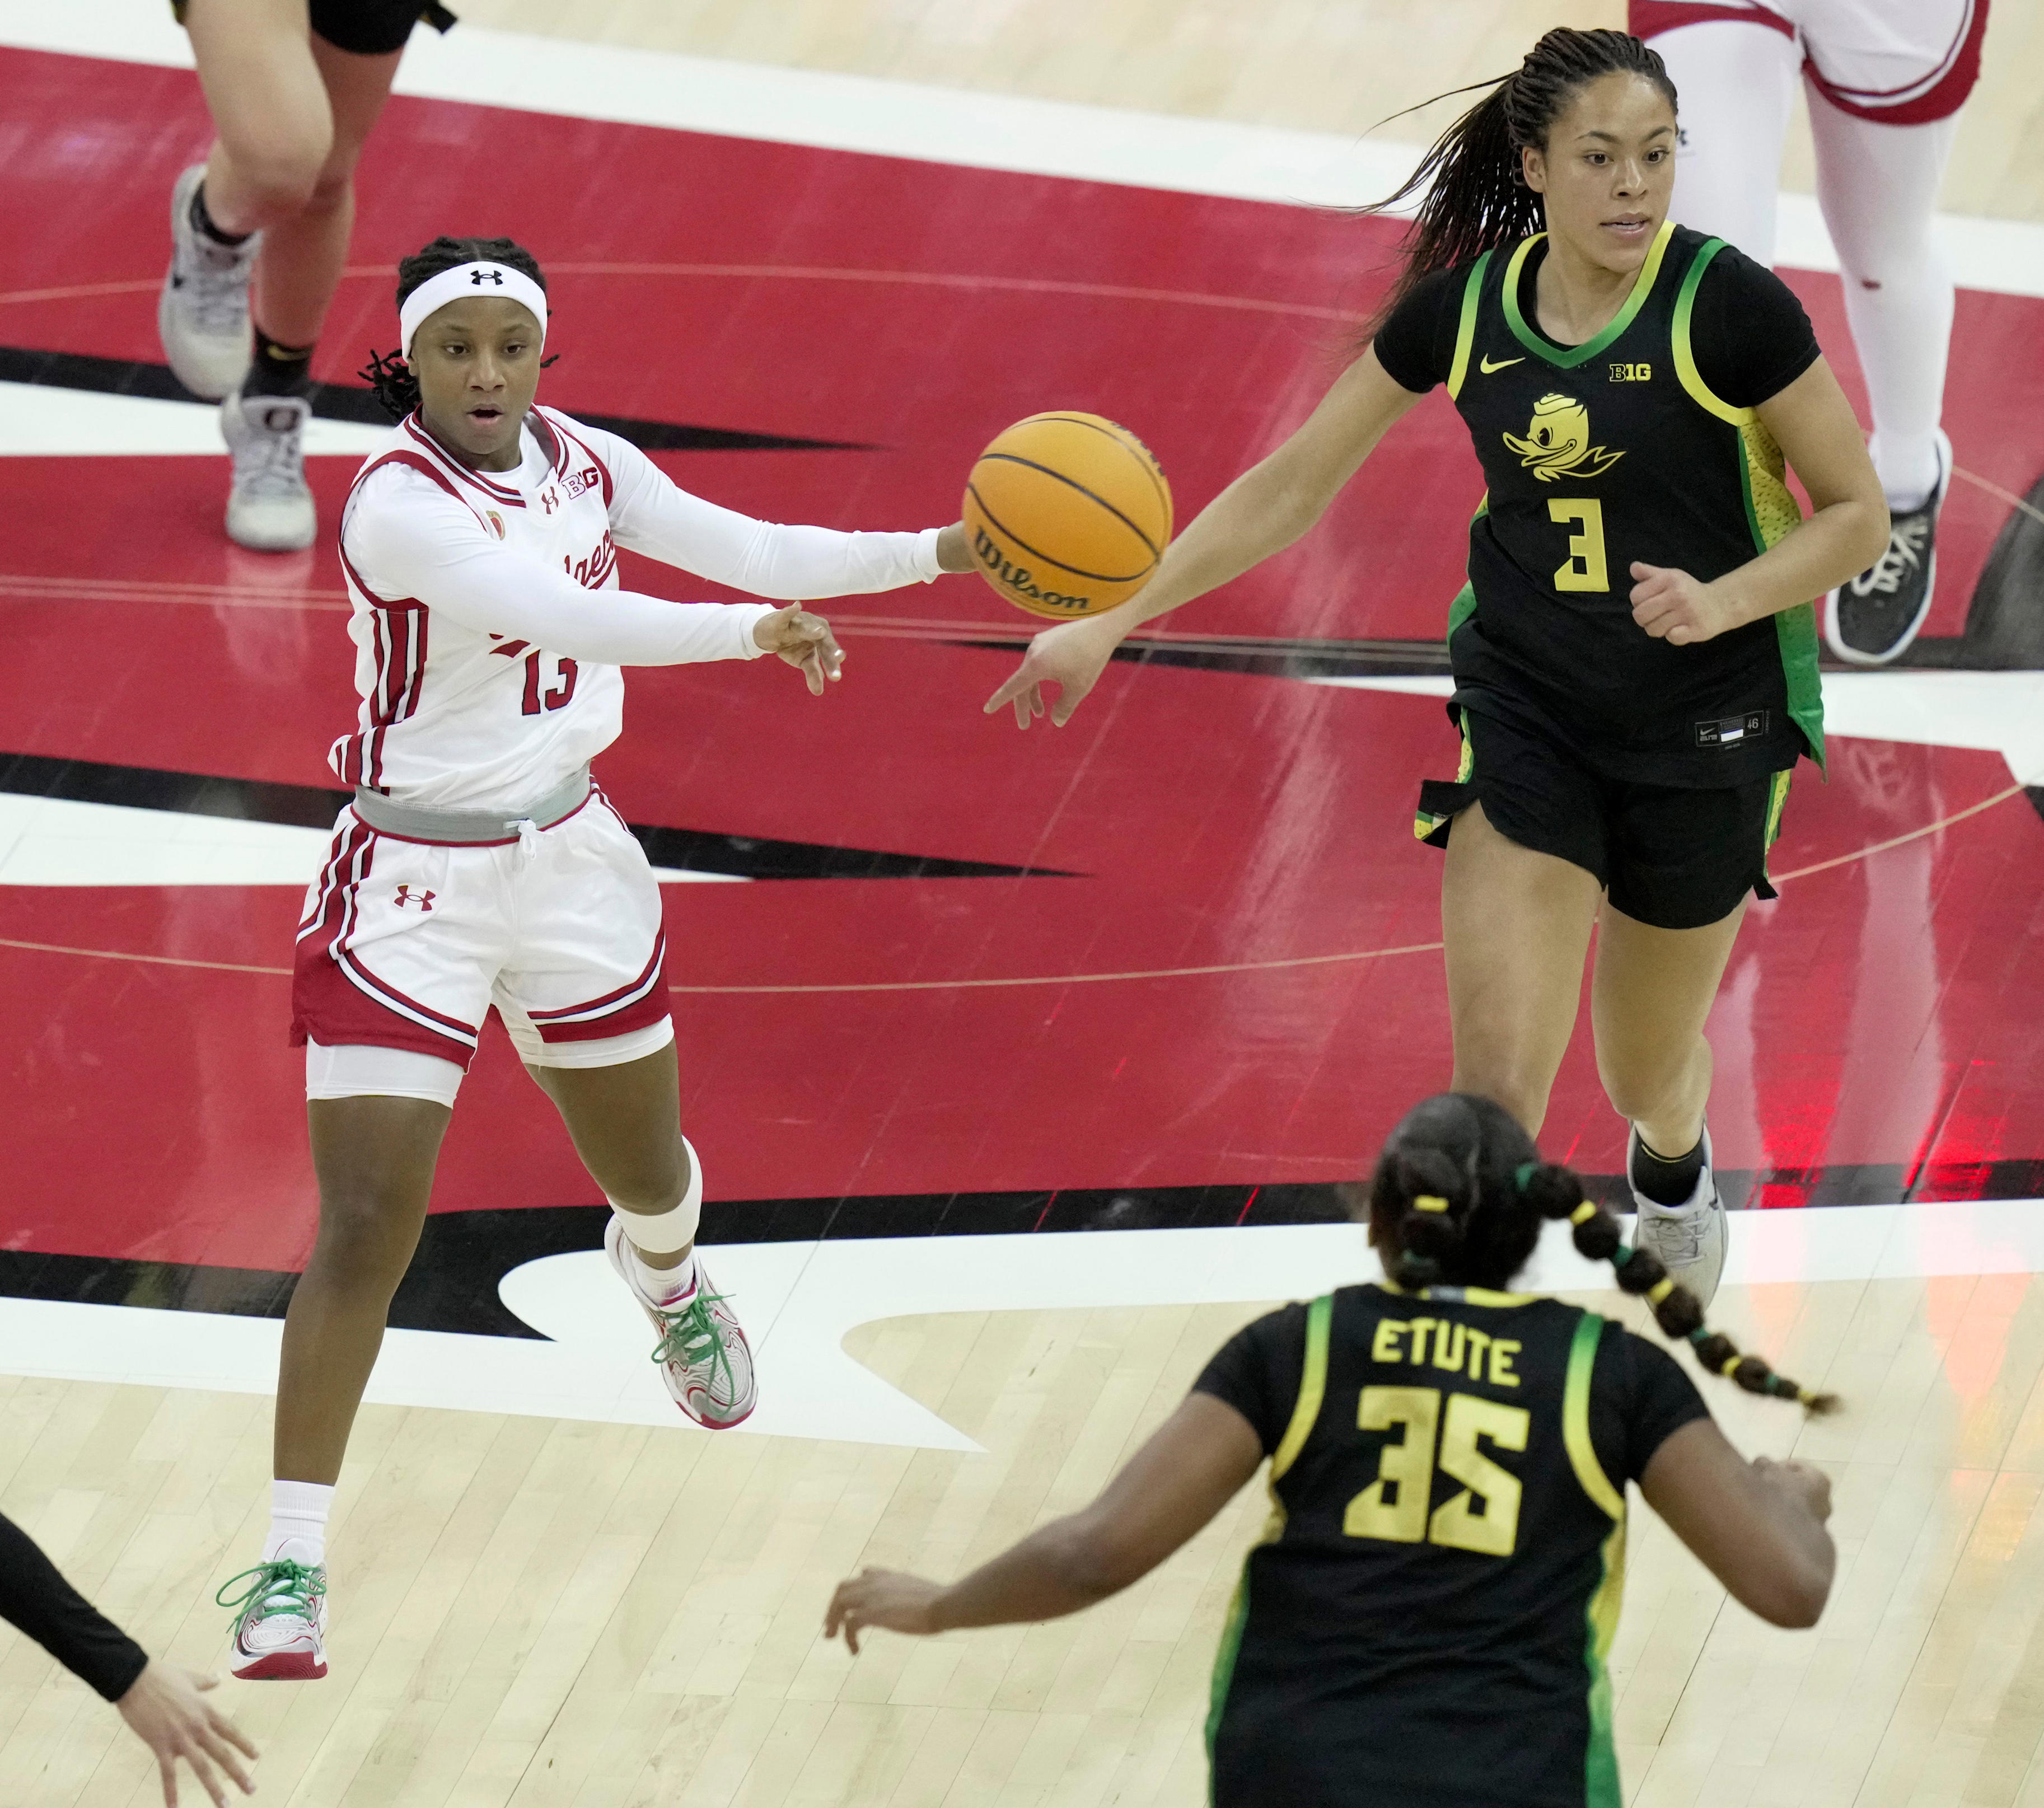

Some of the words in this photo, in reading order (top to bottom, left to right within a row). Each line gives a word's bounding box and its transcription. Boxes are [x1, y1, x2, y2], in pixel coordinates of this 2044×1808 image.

[561, 466, 598, 500] BG
[975, 525, 1089, 609] Wilson
[1547, 498, 1610, 592] 3
[521, 648, 578, 715] 13
[1747, 718, 1759, 730] 46
[1371, 1316, 1523, 1388] ETUTE
[1343, 1384, 1531, 1557] 35
